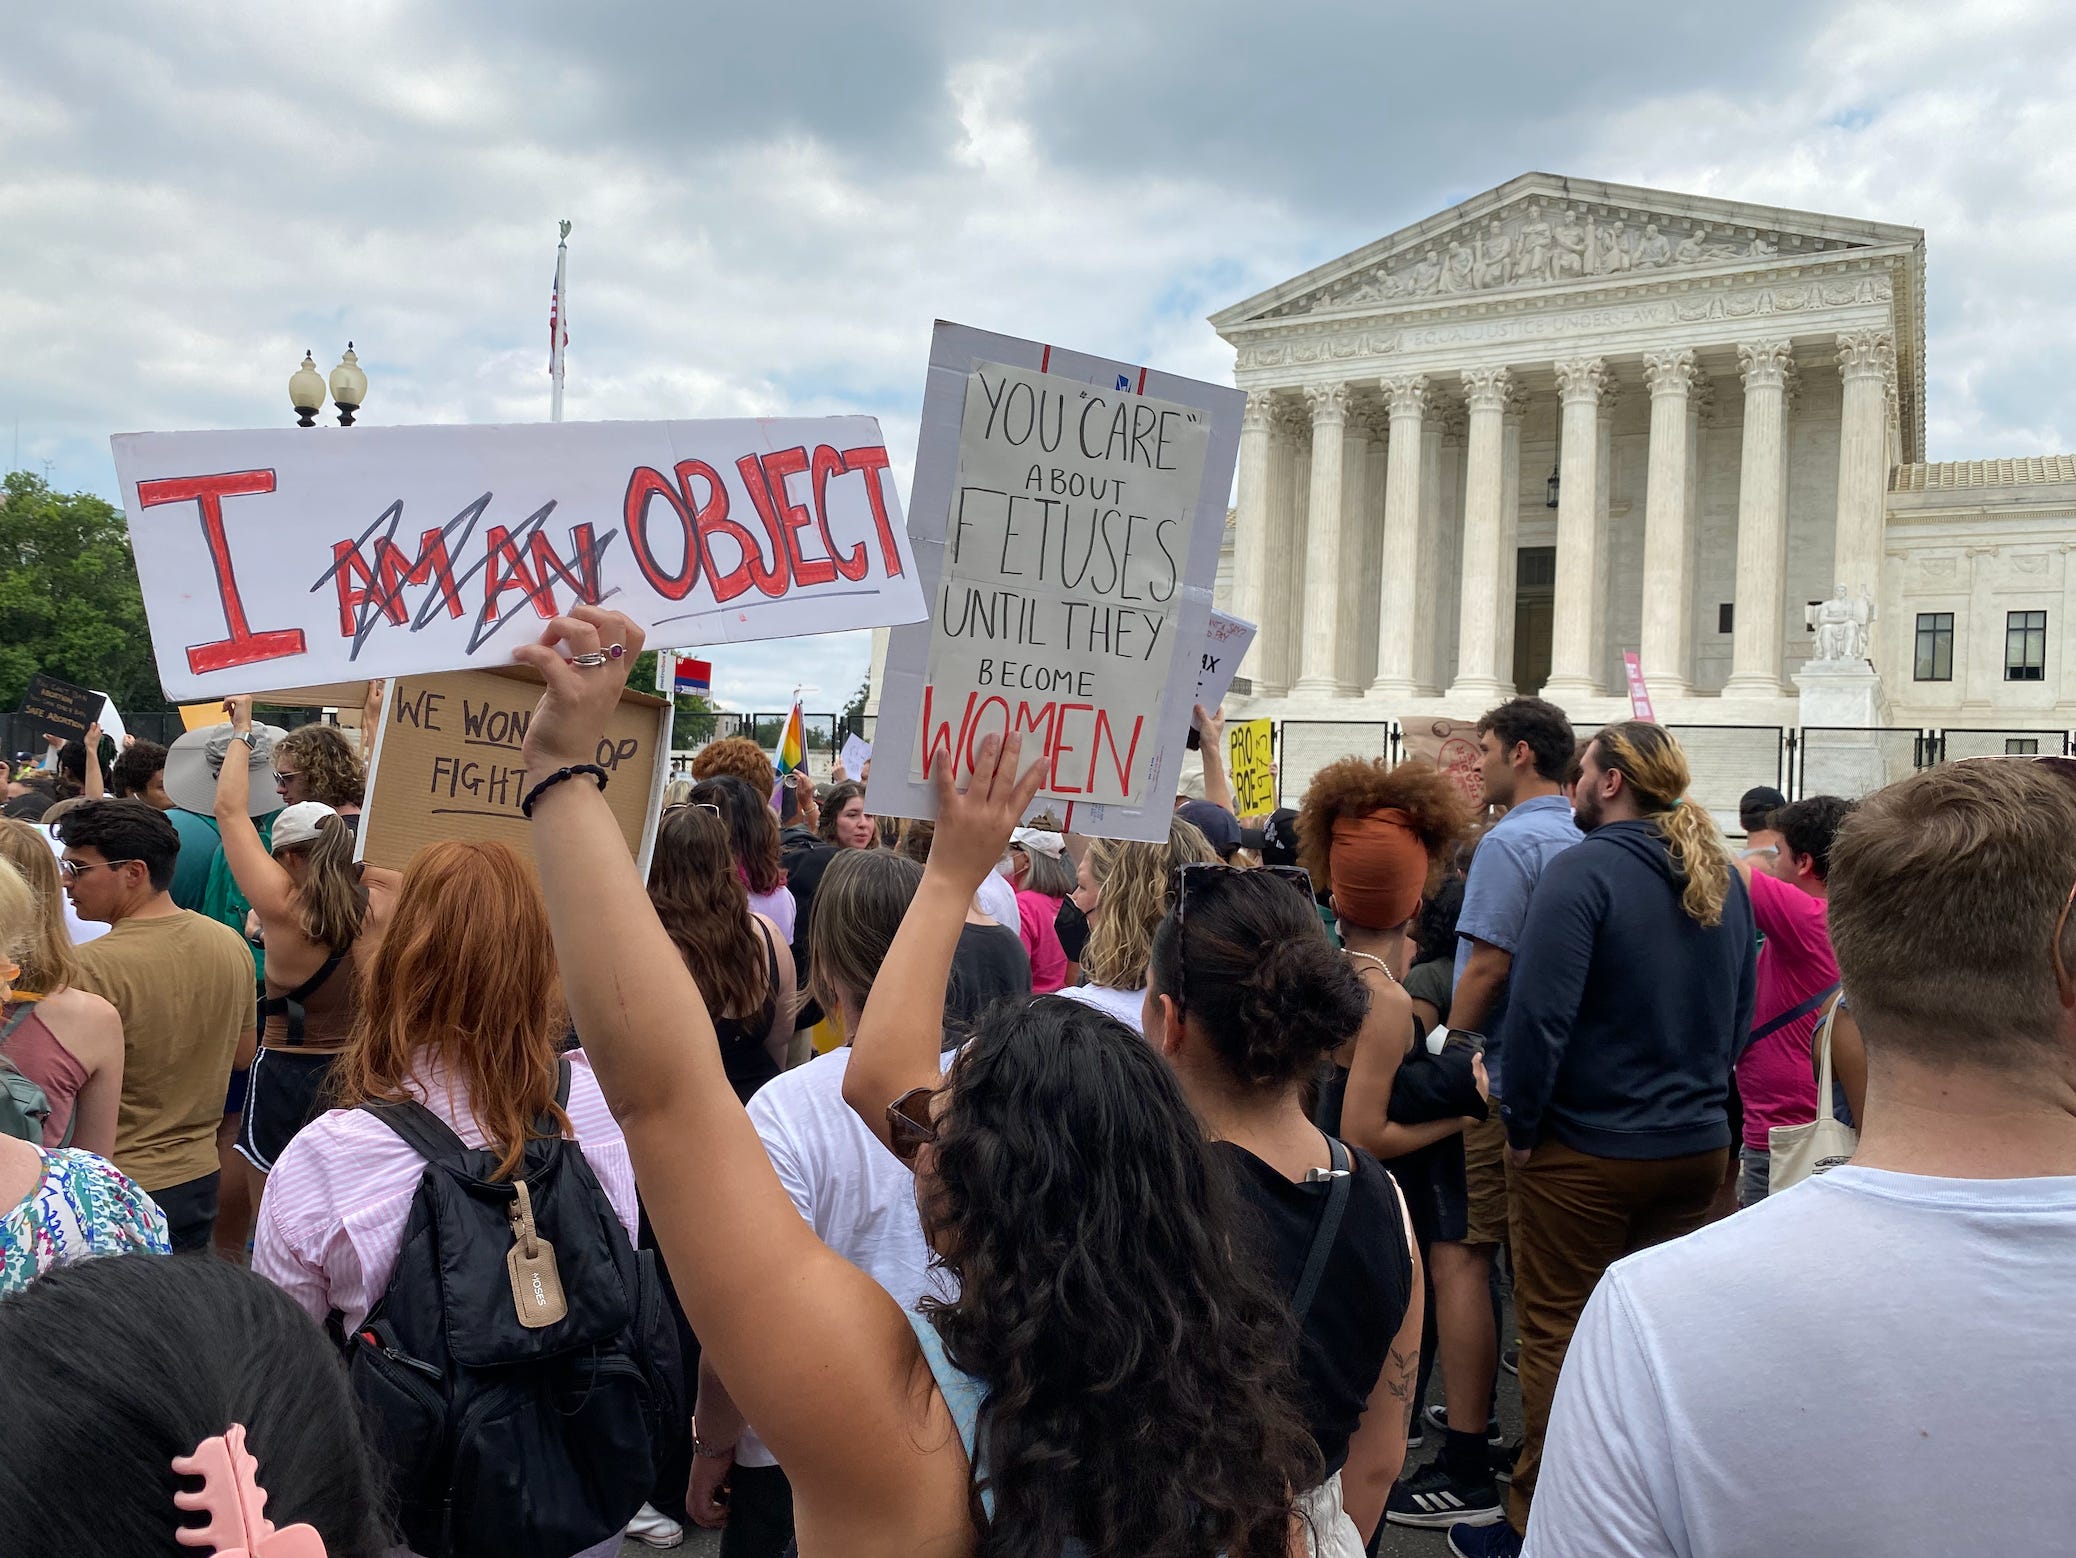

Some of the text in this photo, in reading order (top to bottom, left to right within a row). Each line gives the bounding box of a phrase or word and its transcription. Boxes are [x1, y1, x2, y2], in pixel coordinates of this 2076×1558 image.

[1414, 307, 1657, 346] EQUAL JUSTICE UNDER LAW
[979, 372, 1064, 453] YOU
[1026, 464, 1127, 505] ABOUT
[136, 468, 307, 675] I
[331, 526, 465, 637] AM
[623, 444, 905, 603] OBJECT
[954, 487, 1177, 602] FETUSES
[943, 585, 1164, 661] UNTIL THEY
[978, 658, 1095, 697] BECOME
[397, 686, 638, 771] WE WON OP
[923, 686, 1144, 797] WOMEN
[1231, 726, 1253, 768] PRO
[431, 756, 529, 808] FIGHT
[1236, 768, 1258, 813] ROE
[1256, 734, 1272, 805] 1973
[531, 1272, 547, 1306] MOSES
